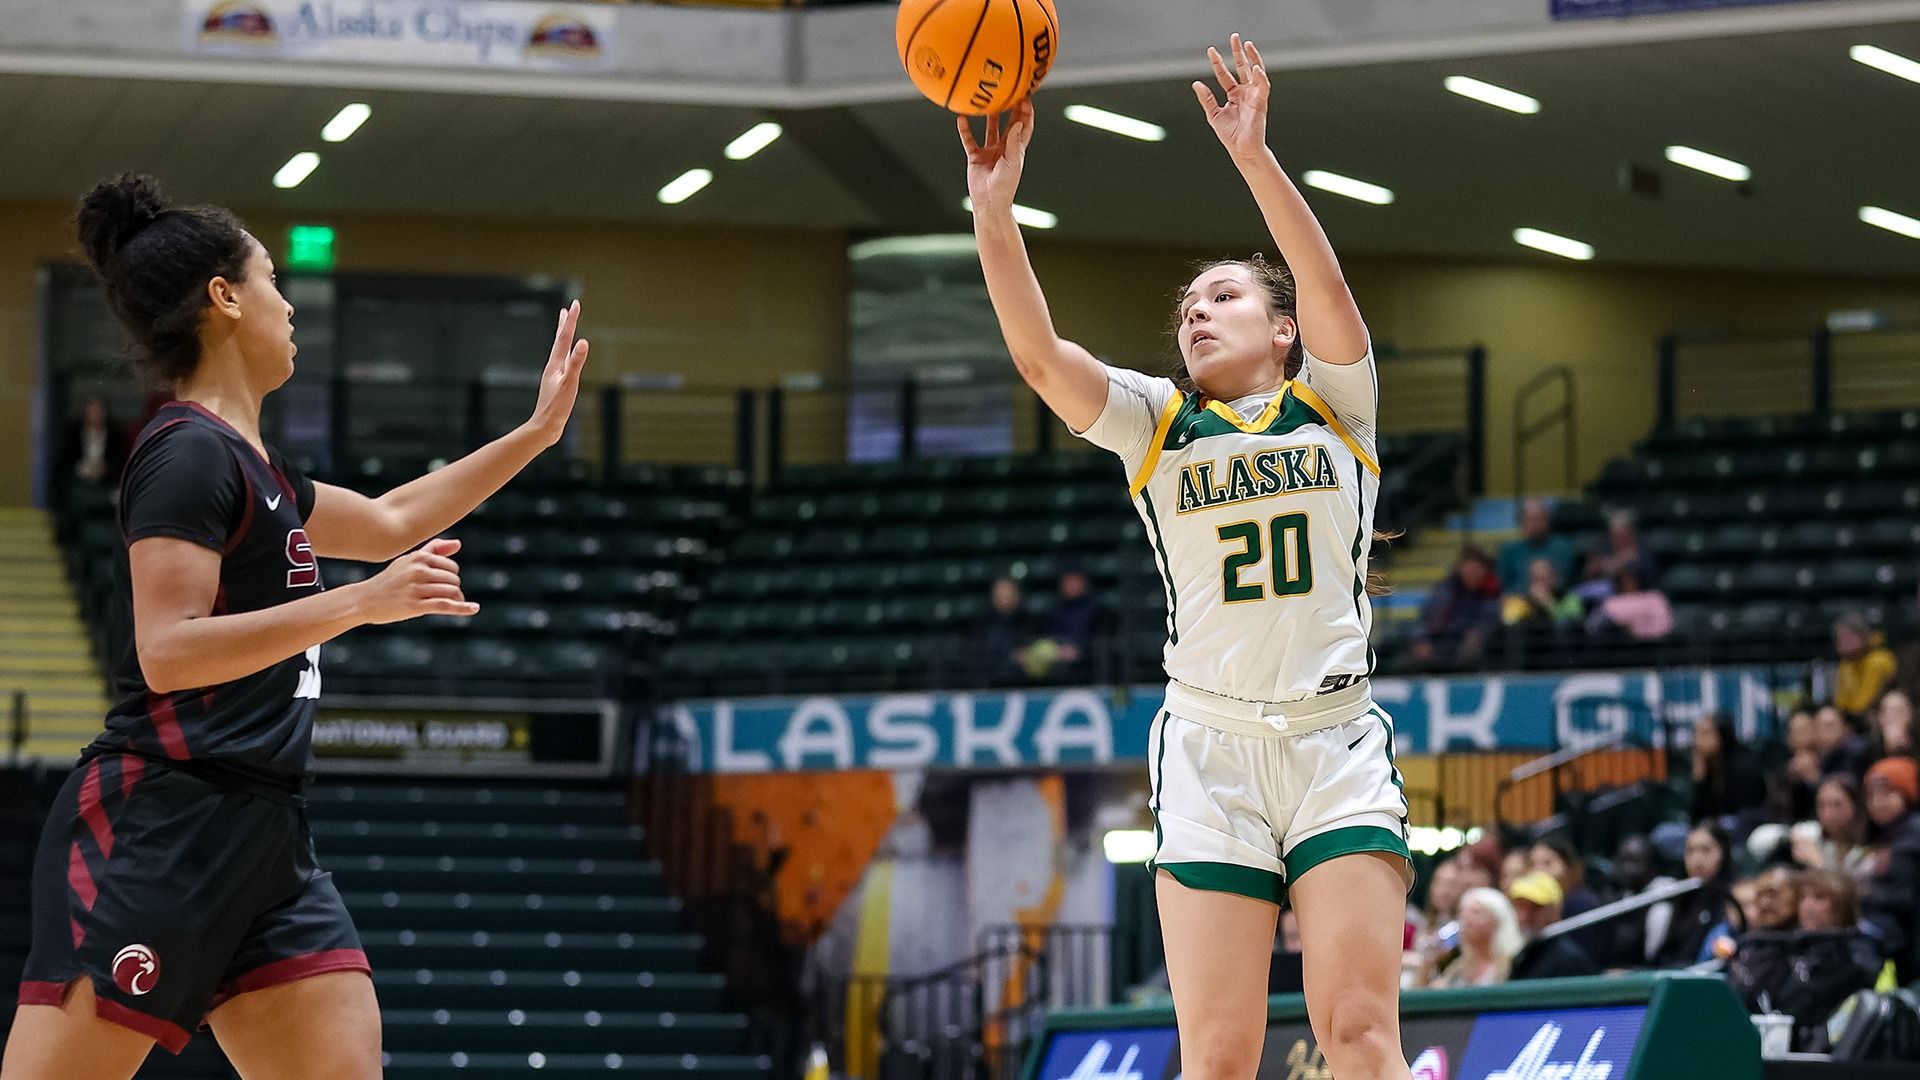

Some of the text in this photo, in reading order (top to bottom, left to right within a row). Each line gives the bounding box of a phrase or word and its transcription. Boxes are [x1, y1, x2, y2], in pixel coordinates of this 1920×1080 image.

[1176, 443, 1341, 515] ALASKA
[1215, 510, 1315, 606] 20
[634, 691, 1114, 774] ALASKA
